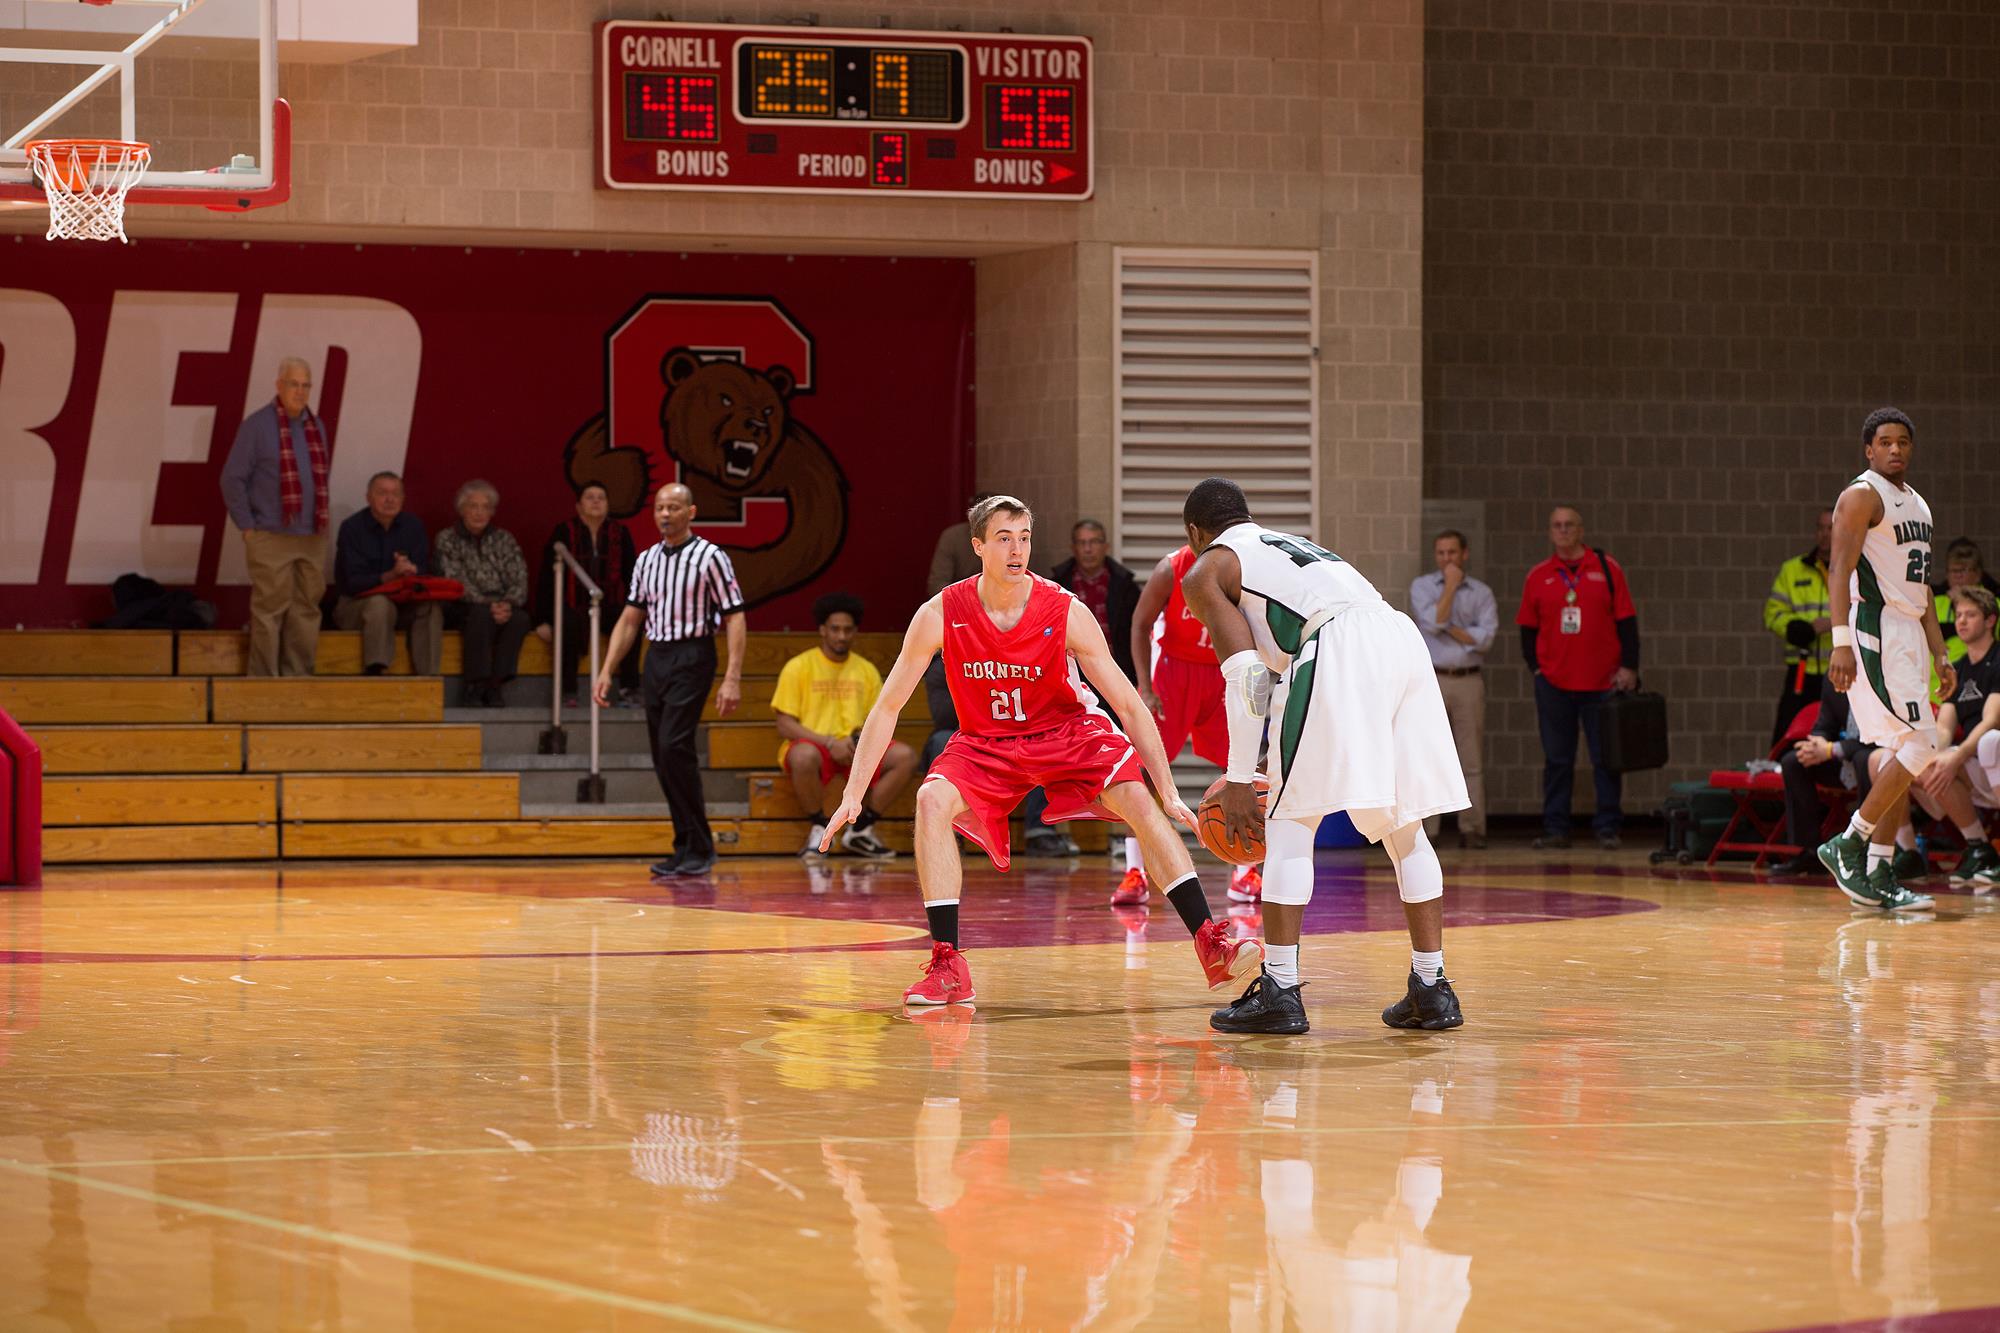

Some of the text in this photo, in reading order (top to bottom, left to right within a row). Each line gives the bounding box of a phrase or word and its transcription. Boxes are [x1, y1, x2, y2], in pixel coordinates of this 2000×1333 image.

[620, 35, 721, 68] CORNELL
[975, 46, 1081, 79] VISITOR
[757, 50, 908, 116] 25 9
[641, 76, 715, 139] 45
[1000, 87, 1071, 149] 56
[656, 149, 729, 178] BONUS
[798, 153, 867, 178] PERIOD
[875, 134, 903, 184] 2
[974, 157, 1044, 186] BONUS
[990, 687, 1027, 722] 21
[1905, 701, 1921, 722] D
